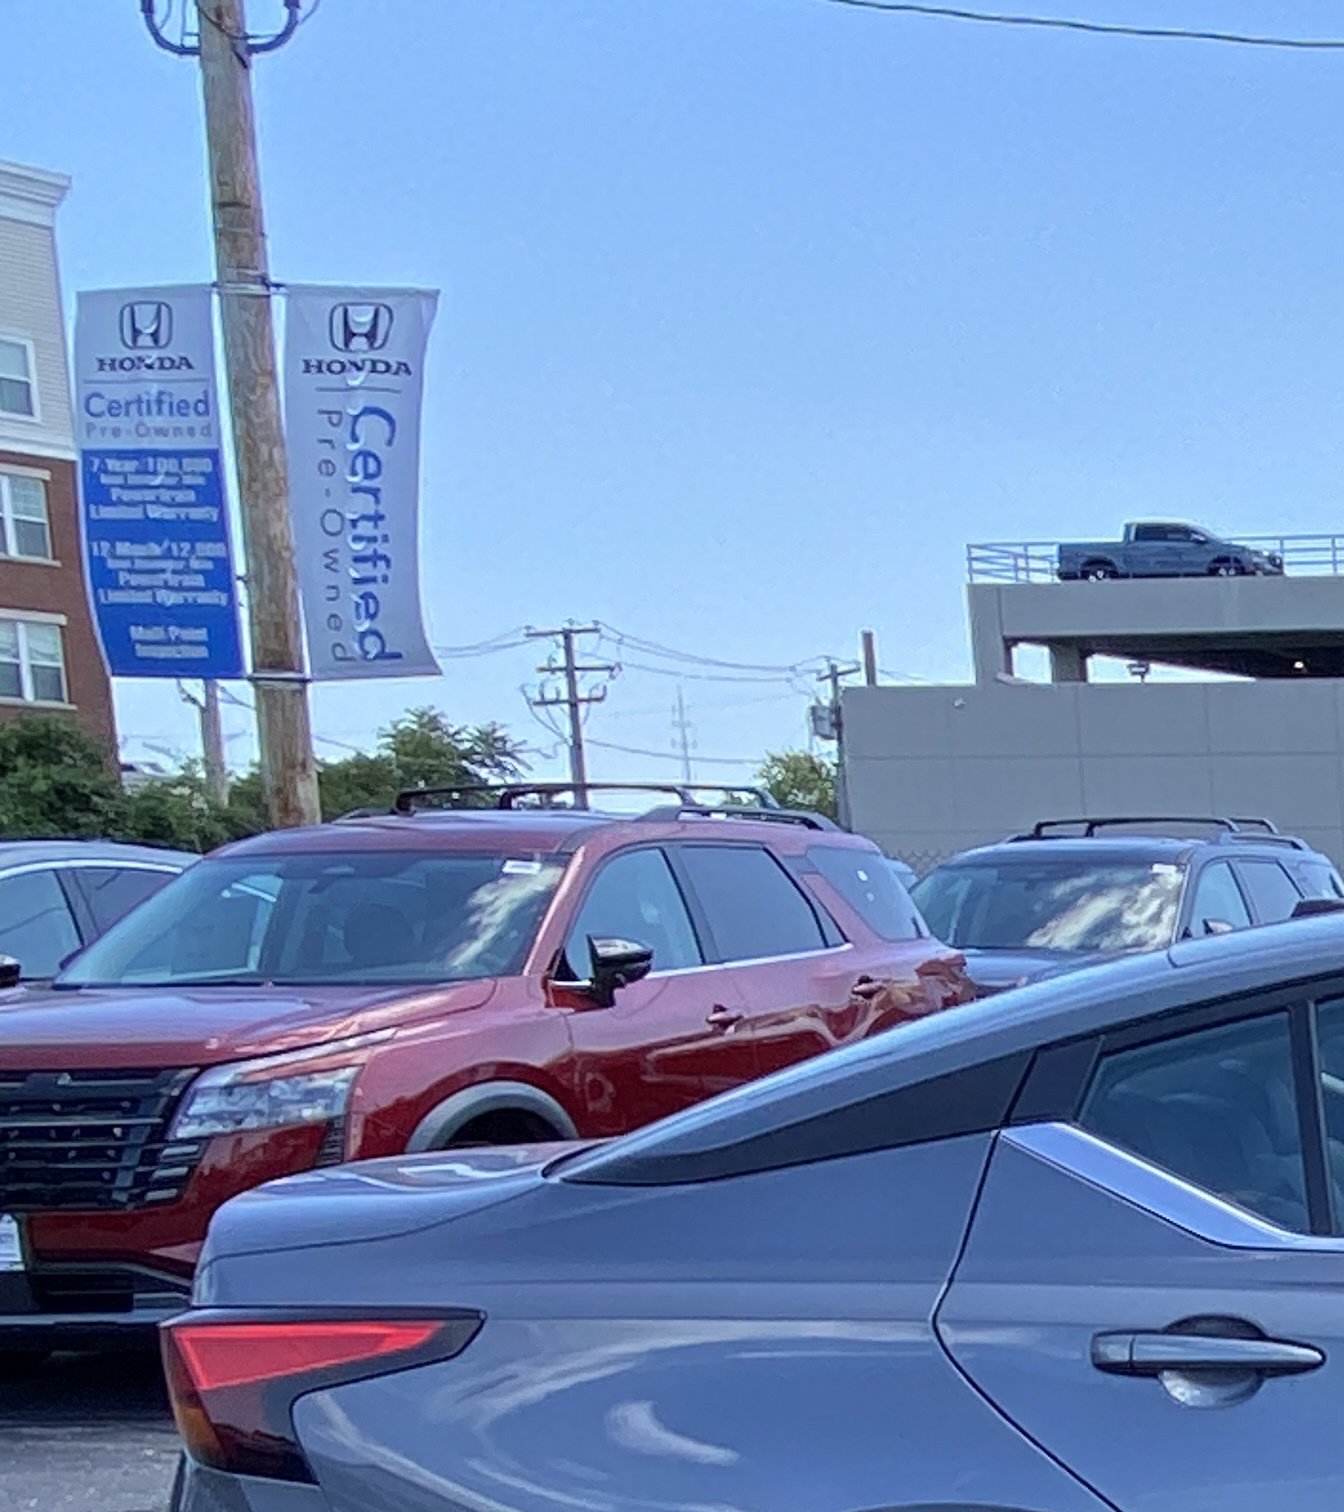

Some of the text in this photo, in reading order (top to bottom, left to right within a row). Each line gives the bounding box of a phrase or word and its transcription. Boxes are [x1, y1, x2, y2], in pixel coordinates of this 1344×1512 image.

[96, 355, 196, 372] HONDA
[301, 358, 413, 376] HONDA
[84, 389, 210, 419] Certified
[349, 406, 403, 661] Certified
